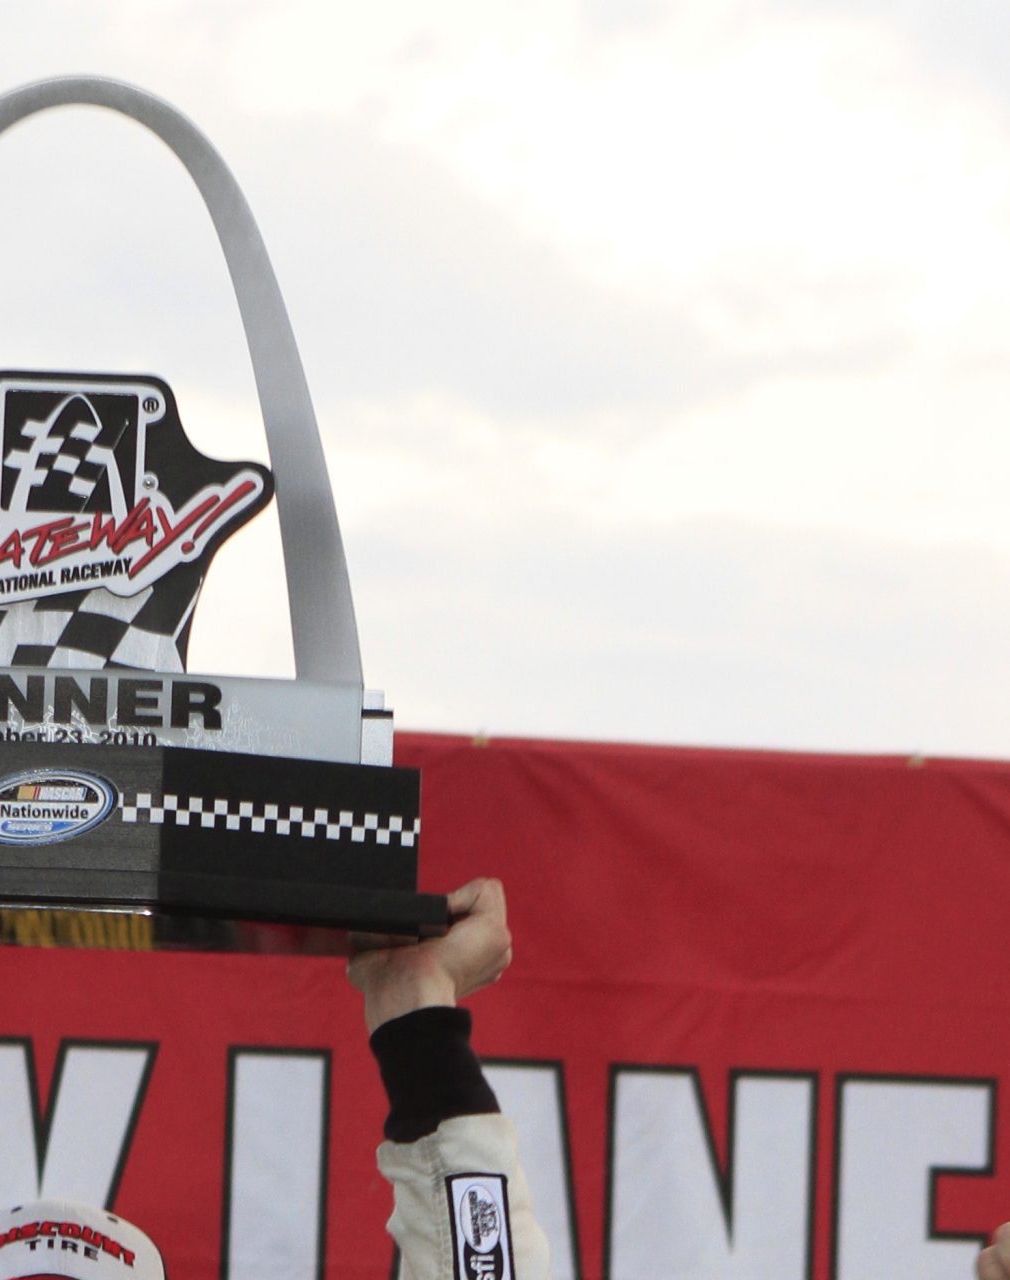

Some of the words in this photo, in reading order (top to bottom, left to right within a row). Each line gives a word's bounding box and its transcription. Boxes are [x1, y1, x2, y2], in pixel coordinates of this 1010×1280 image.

[60, 556, 133, 583] RACEWAY
[0, 803, 89, 820] Nationwide
[25, 1238, 99, 1261] TIRE
